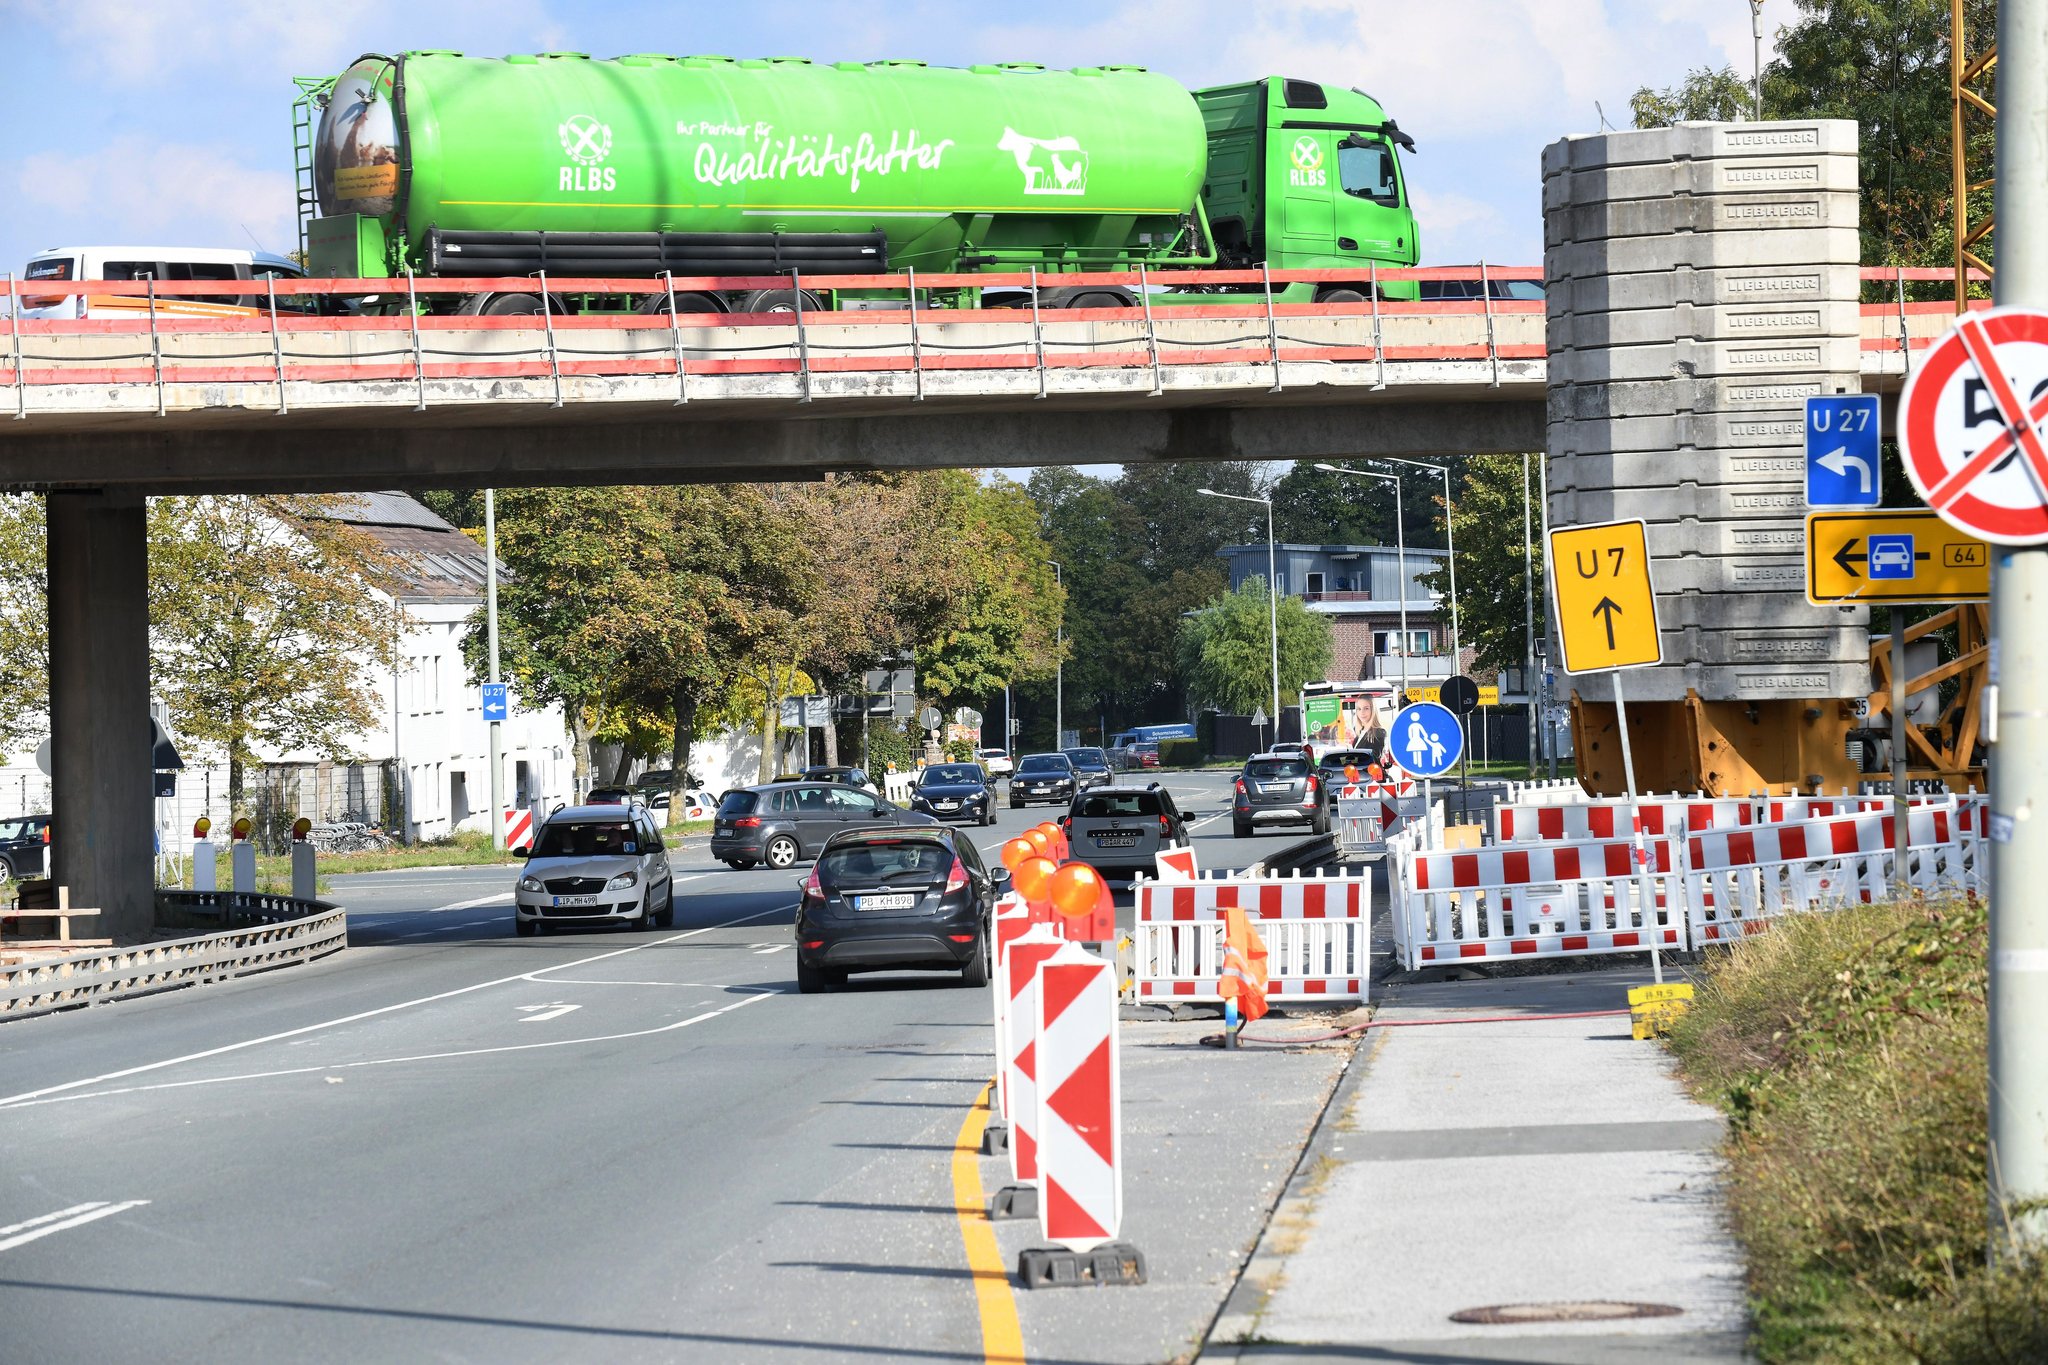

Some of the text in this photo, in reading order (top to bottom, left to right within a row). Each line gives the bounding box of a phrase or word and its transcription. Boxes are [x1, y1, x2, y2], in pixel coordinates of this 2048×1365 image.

[676, 120, 774, 143] Ihr Partner für
[1727, 133, 1814, 146] LIEBHERR
[693, 129, 955, 193] Qualitätsfutter
[559, 166, 617, 192] RLBS
[1290, 168, 1327, 187] RLBS
[1727, 170, 1814, 182] LIEBHERR
[1727, 206, 1815, 218] LIEBHERR
[1728, 279, 1816, 292] LIEBHERR
[1729, 315, 1816, 327] LIEBHERR
[1729, 352, 1816, 364] LIEBHERR
[1813, 409, 1871, 432] U 27
[1731, 424, 1804, 436] LIEBHER
[1733, 459, 1804, 472] LIEBHER
[1734, 496, 1805, 508] LIEBHER
[1735, 532, 1804, 544] LIEBHER
[1953, 547, 1975, 563] 64
[1575, 547, 1625, 579] U 7
[1739, 640, 1826, 653] LIEBHERR
[1739, 675, 1827, 689] LIEBHERR
[484, 687, 504, 697] U 27
[1855, 700, 1867, 715] 25
[559, 897, 570, 905] LIP
[584, 896, 596, 904] 499
[861, 895, 913, 907] PB KH 898
